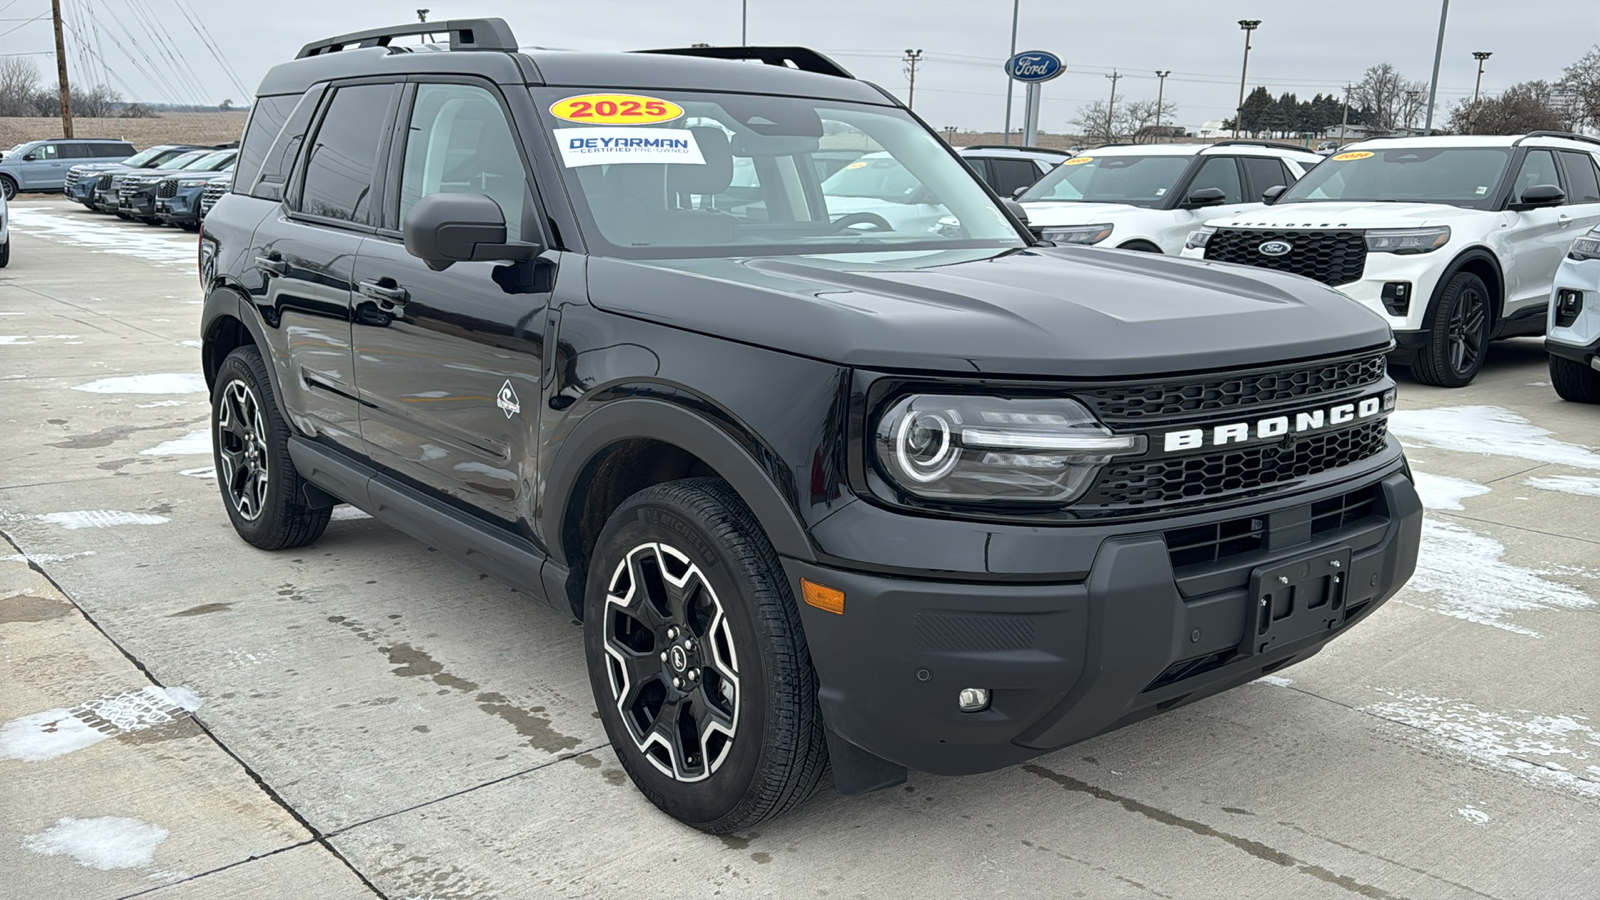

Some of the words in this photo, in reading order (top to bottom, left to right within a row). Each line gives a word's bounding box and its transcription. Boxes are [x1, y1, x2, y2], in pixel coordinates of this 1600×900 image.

[1014, 56, 1050, 76] Ford
[568, 100, 669, 119] 2025
[569, 137, 689, 150] DEYARMAN
[1264, 243, 1284, 253] Ford
[1163, 396, 1380, 453] BRONCO
[659, 513, 716, 564] MICHELIN
